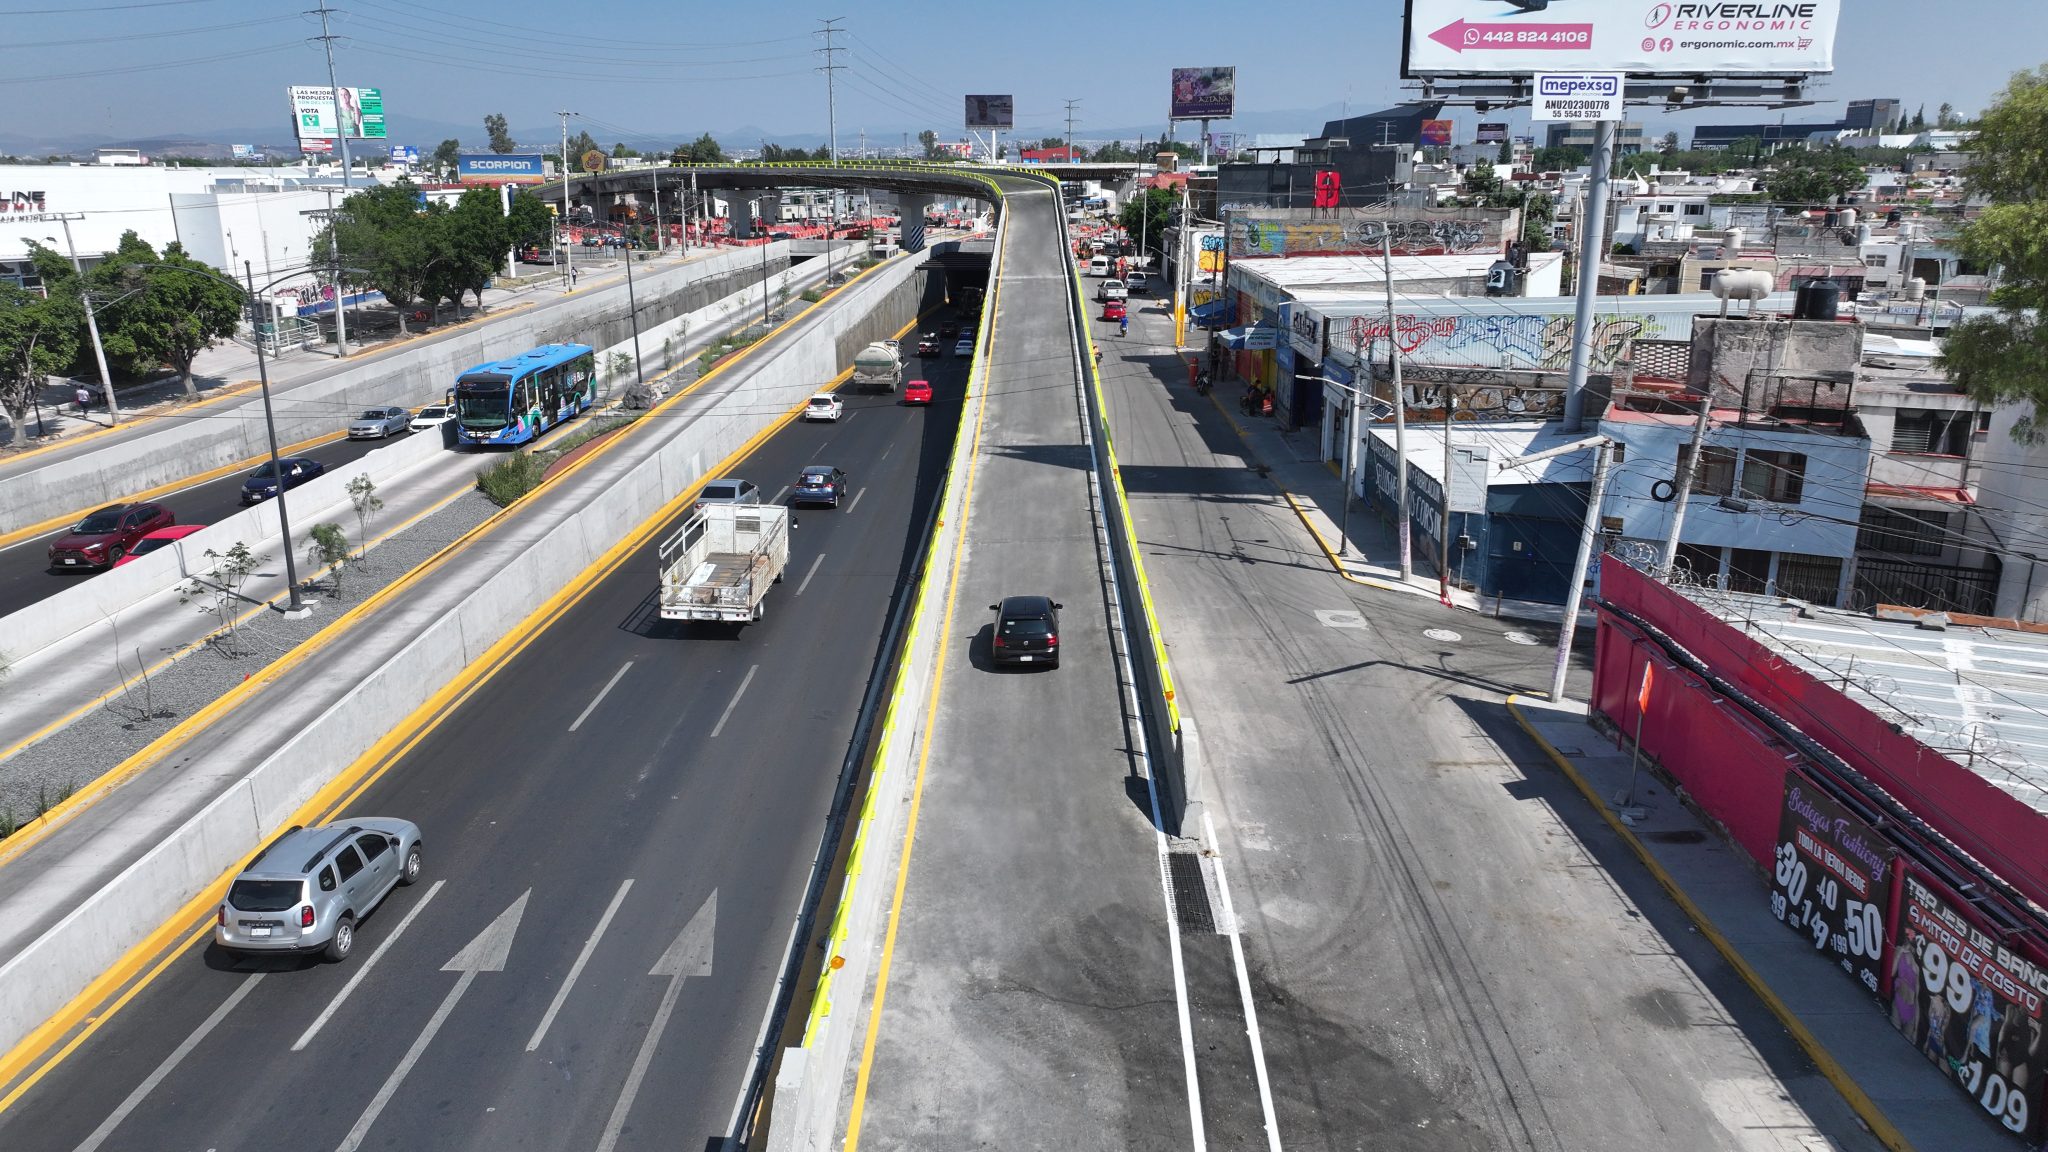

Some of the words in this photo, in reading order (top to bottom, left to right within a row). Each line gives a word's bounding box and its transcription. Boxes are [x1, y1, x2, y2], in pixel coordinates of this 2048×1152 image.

[1677, 3, 1817, 18] RIVERLINE
[1674, 20, 1812, 30] ERGONOMIC
[1483, 31, 1514, 43] 442
[1517, 31, 1547, 43] 824
[1551, 31, 1588, 43] 4106
[1681, 39, 1795, 50] ergonomic.com.mx
[1545, 81, 1612, 94] mepexsa
[1545, 100, 1610, 110] ANU202300778
[469, 160, 531, 170] SCORPION
[1788, 787, 1830, 832] Bodegas
[1798, 831, 1813, 853] TODA
[1813, 843, 1822, 860] LA
[1824, 848, 1845, 877] TIENDA
[1845, 866, 1866, 894] DESDE
[1775, 842, 1807, 906] $30
[1816, 875, 1838, 911] $40
[1844, 899, 1883, 961] $50
[1907, 876, 1967, 938] TRAJES
[1969, 927, 1994, 958] DE
[1997, 945, 2048, 996] BAÑO
[1921, 918, 1961, 955] MITAD
[1961, 946, 1983, 972] DE
[1982, 963, 2039, 1012] COSTO
